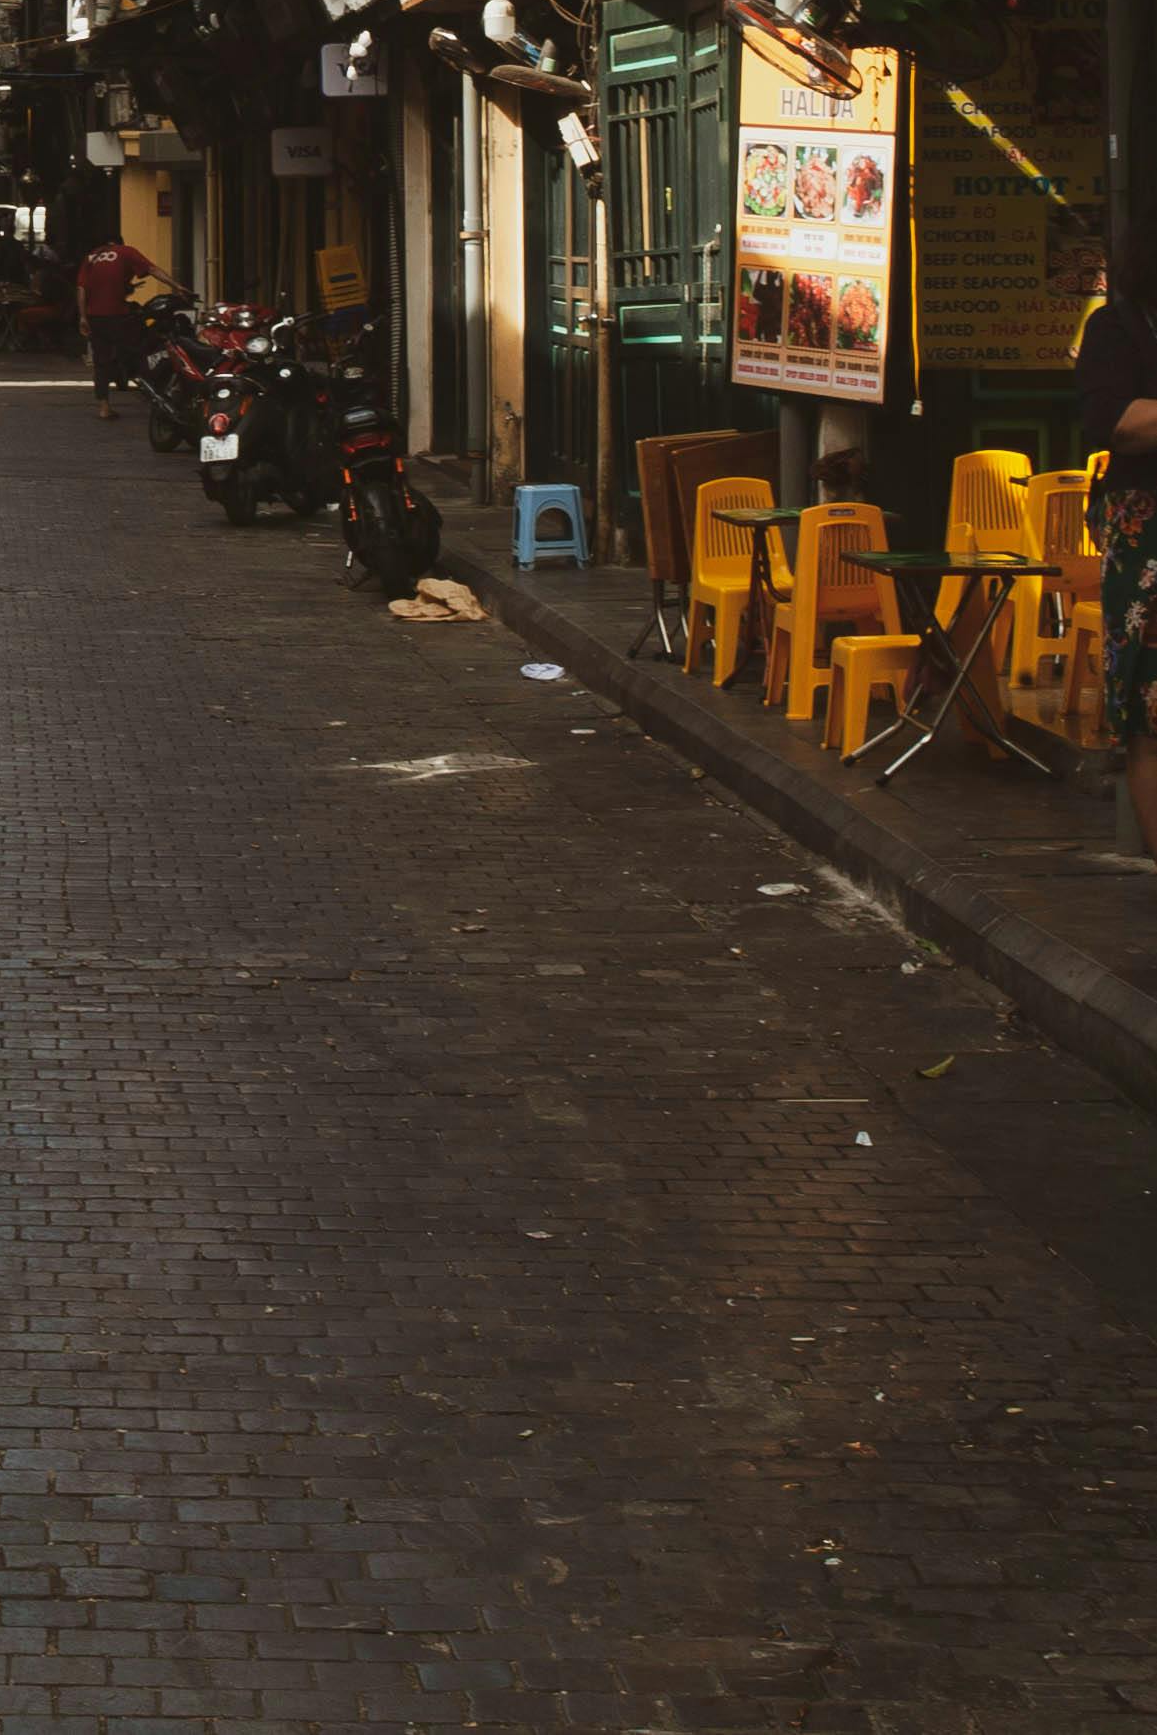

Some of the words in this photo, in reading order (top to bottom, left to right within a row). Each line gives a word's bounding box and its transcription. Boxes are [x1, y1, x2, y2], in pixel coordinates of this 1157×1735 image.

[962, 125, 1037, 139] SEAFOOD
[286, 145, 322, 159] VISA
[953, 176, 1069, 196] HOTPOT
[922, 207, 957, 219] BEEF
[922, 230, 996, 243] CHICKEN
[922, 253, 957, 266] BEEF
[961, 253, 1035, 266] CHICKEN
[922, 276, 957, 290] BEEF
[962, 276, 1039, 290] SEAFOOD
[922, 299, 1000, 313] SEAFOOD
[922, 323, 975, 337] MIXED
[923, 347, 1021, 361] VEGETABLES
